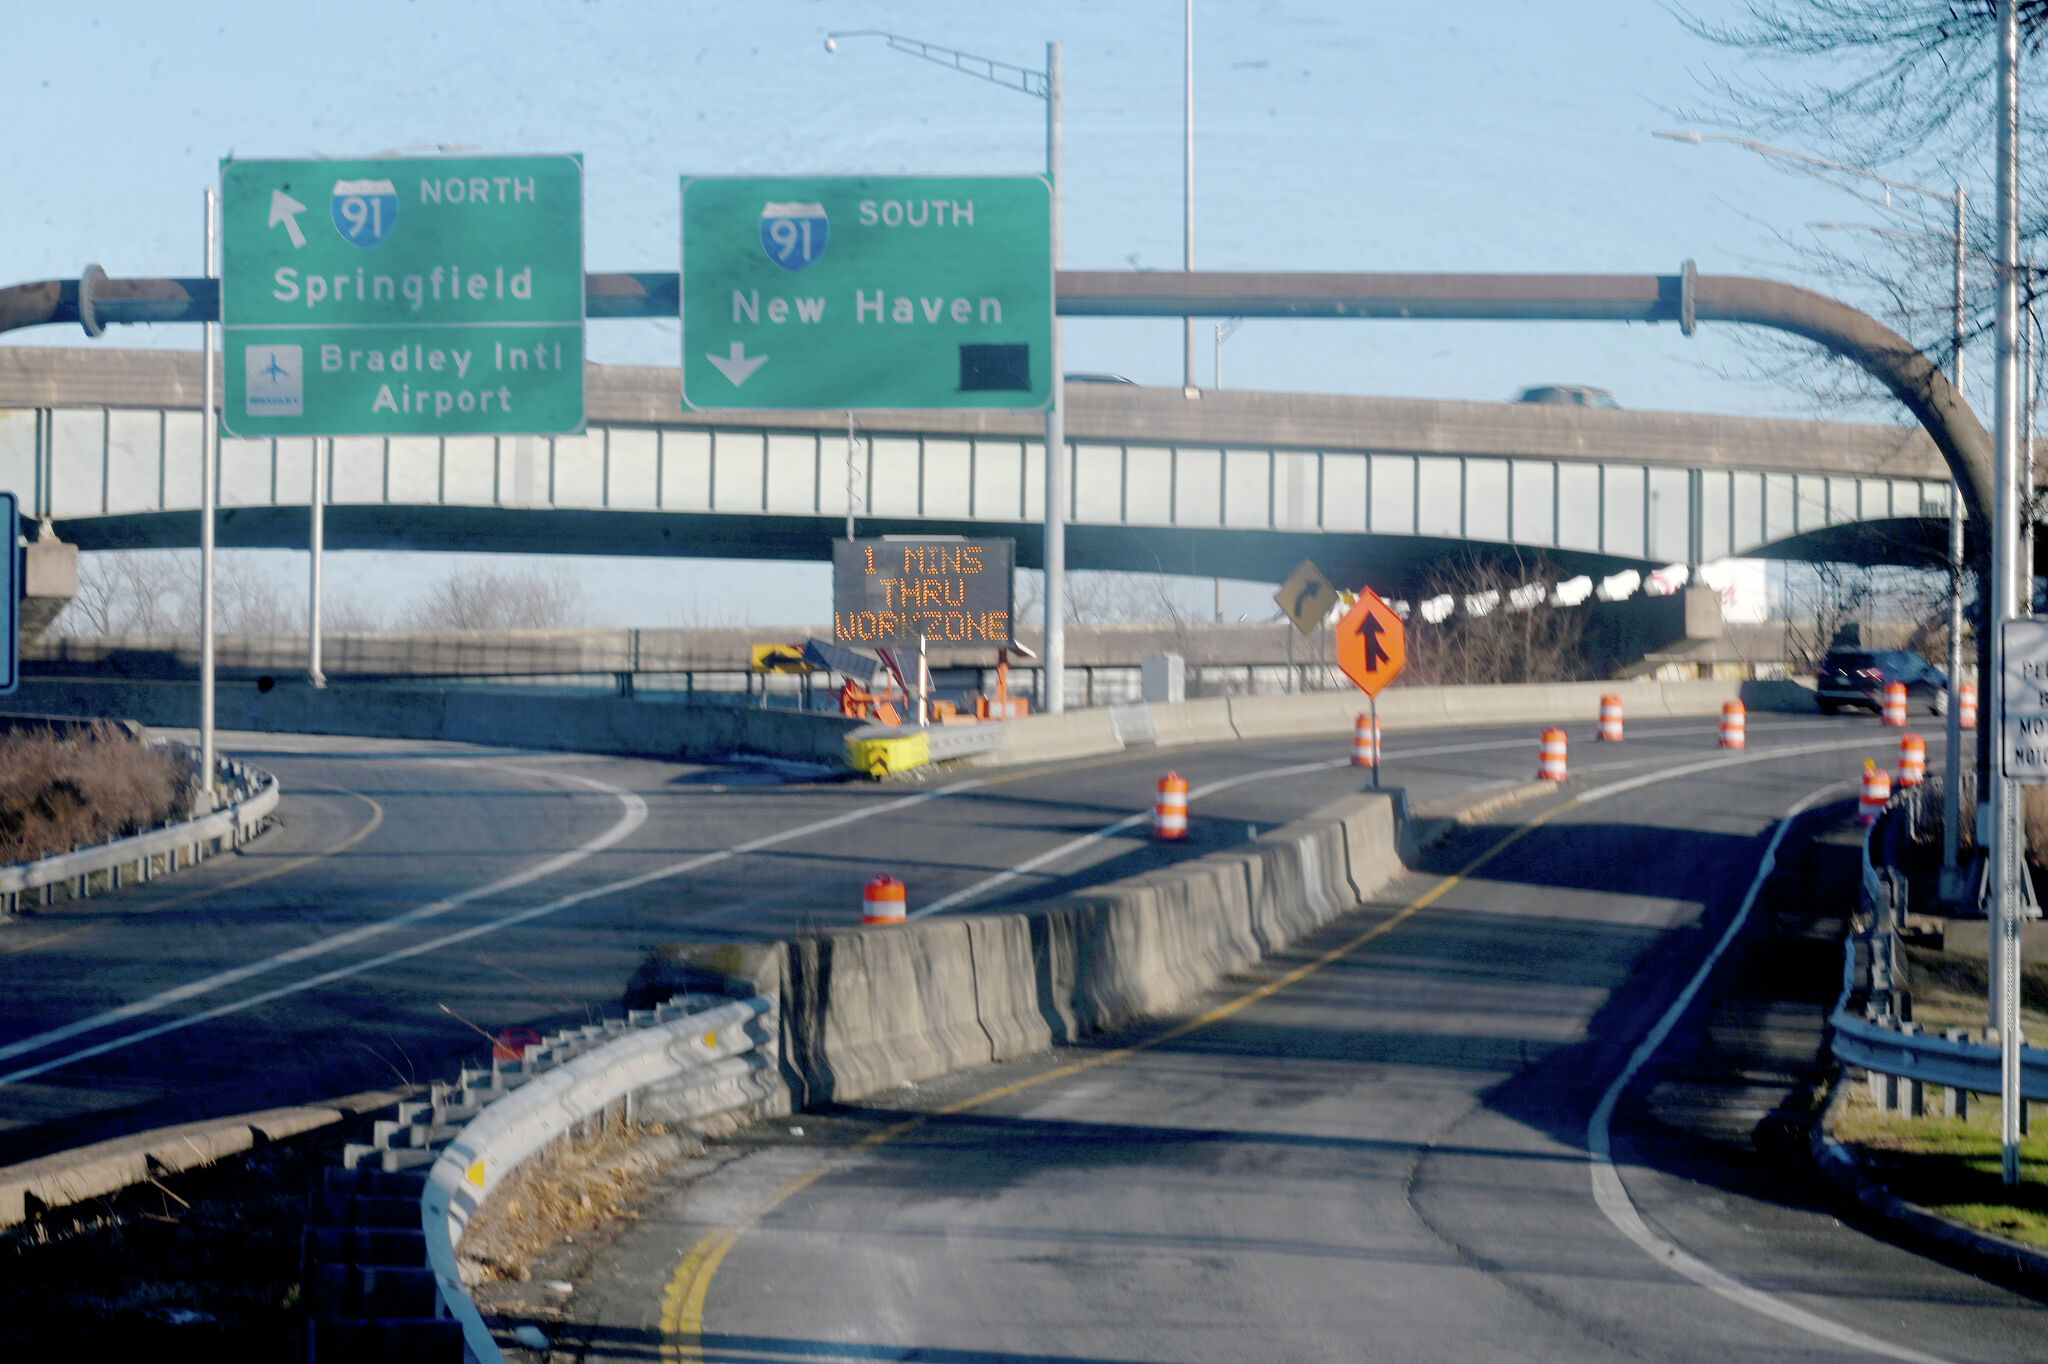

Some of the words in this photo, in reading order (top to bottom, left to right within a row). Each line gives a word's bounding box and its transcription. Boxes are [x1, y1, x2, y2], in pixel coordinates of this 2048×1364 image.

[420, 177, 536, 203] NORTH
[341, 197, 381, 238] 91
[858, 200, 975, 227] SOUTH
[770, 219, 811, 261] 91
[271, 265, 533, 311] Springfield
[732, 289, 826, 324] New
[856, 289, 1003, 324] Haven
[320, 342, 472, 379] Bradley
[495, 341, 563, 372] Intl
[372, 382, 512, 417] Airport
[864, 545, 877, 574] 1
[904, 545, 984, 575] MINS
[879, 577, 966, 608] THRU
